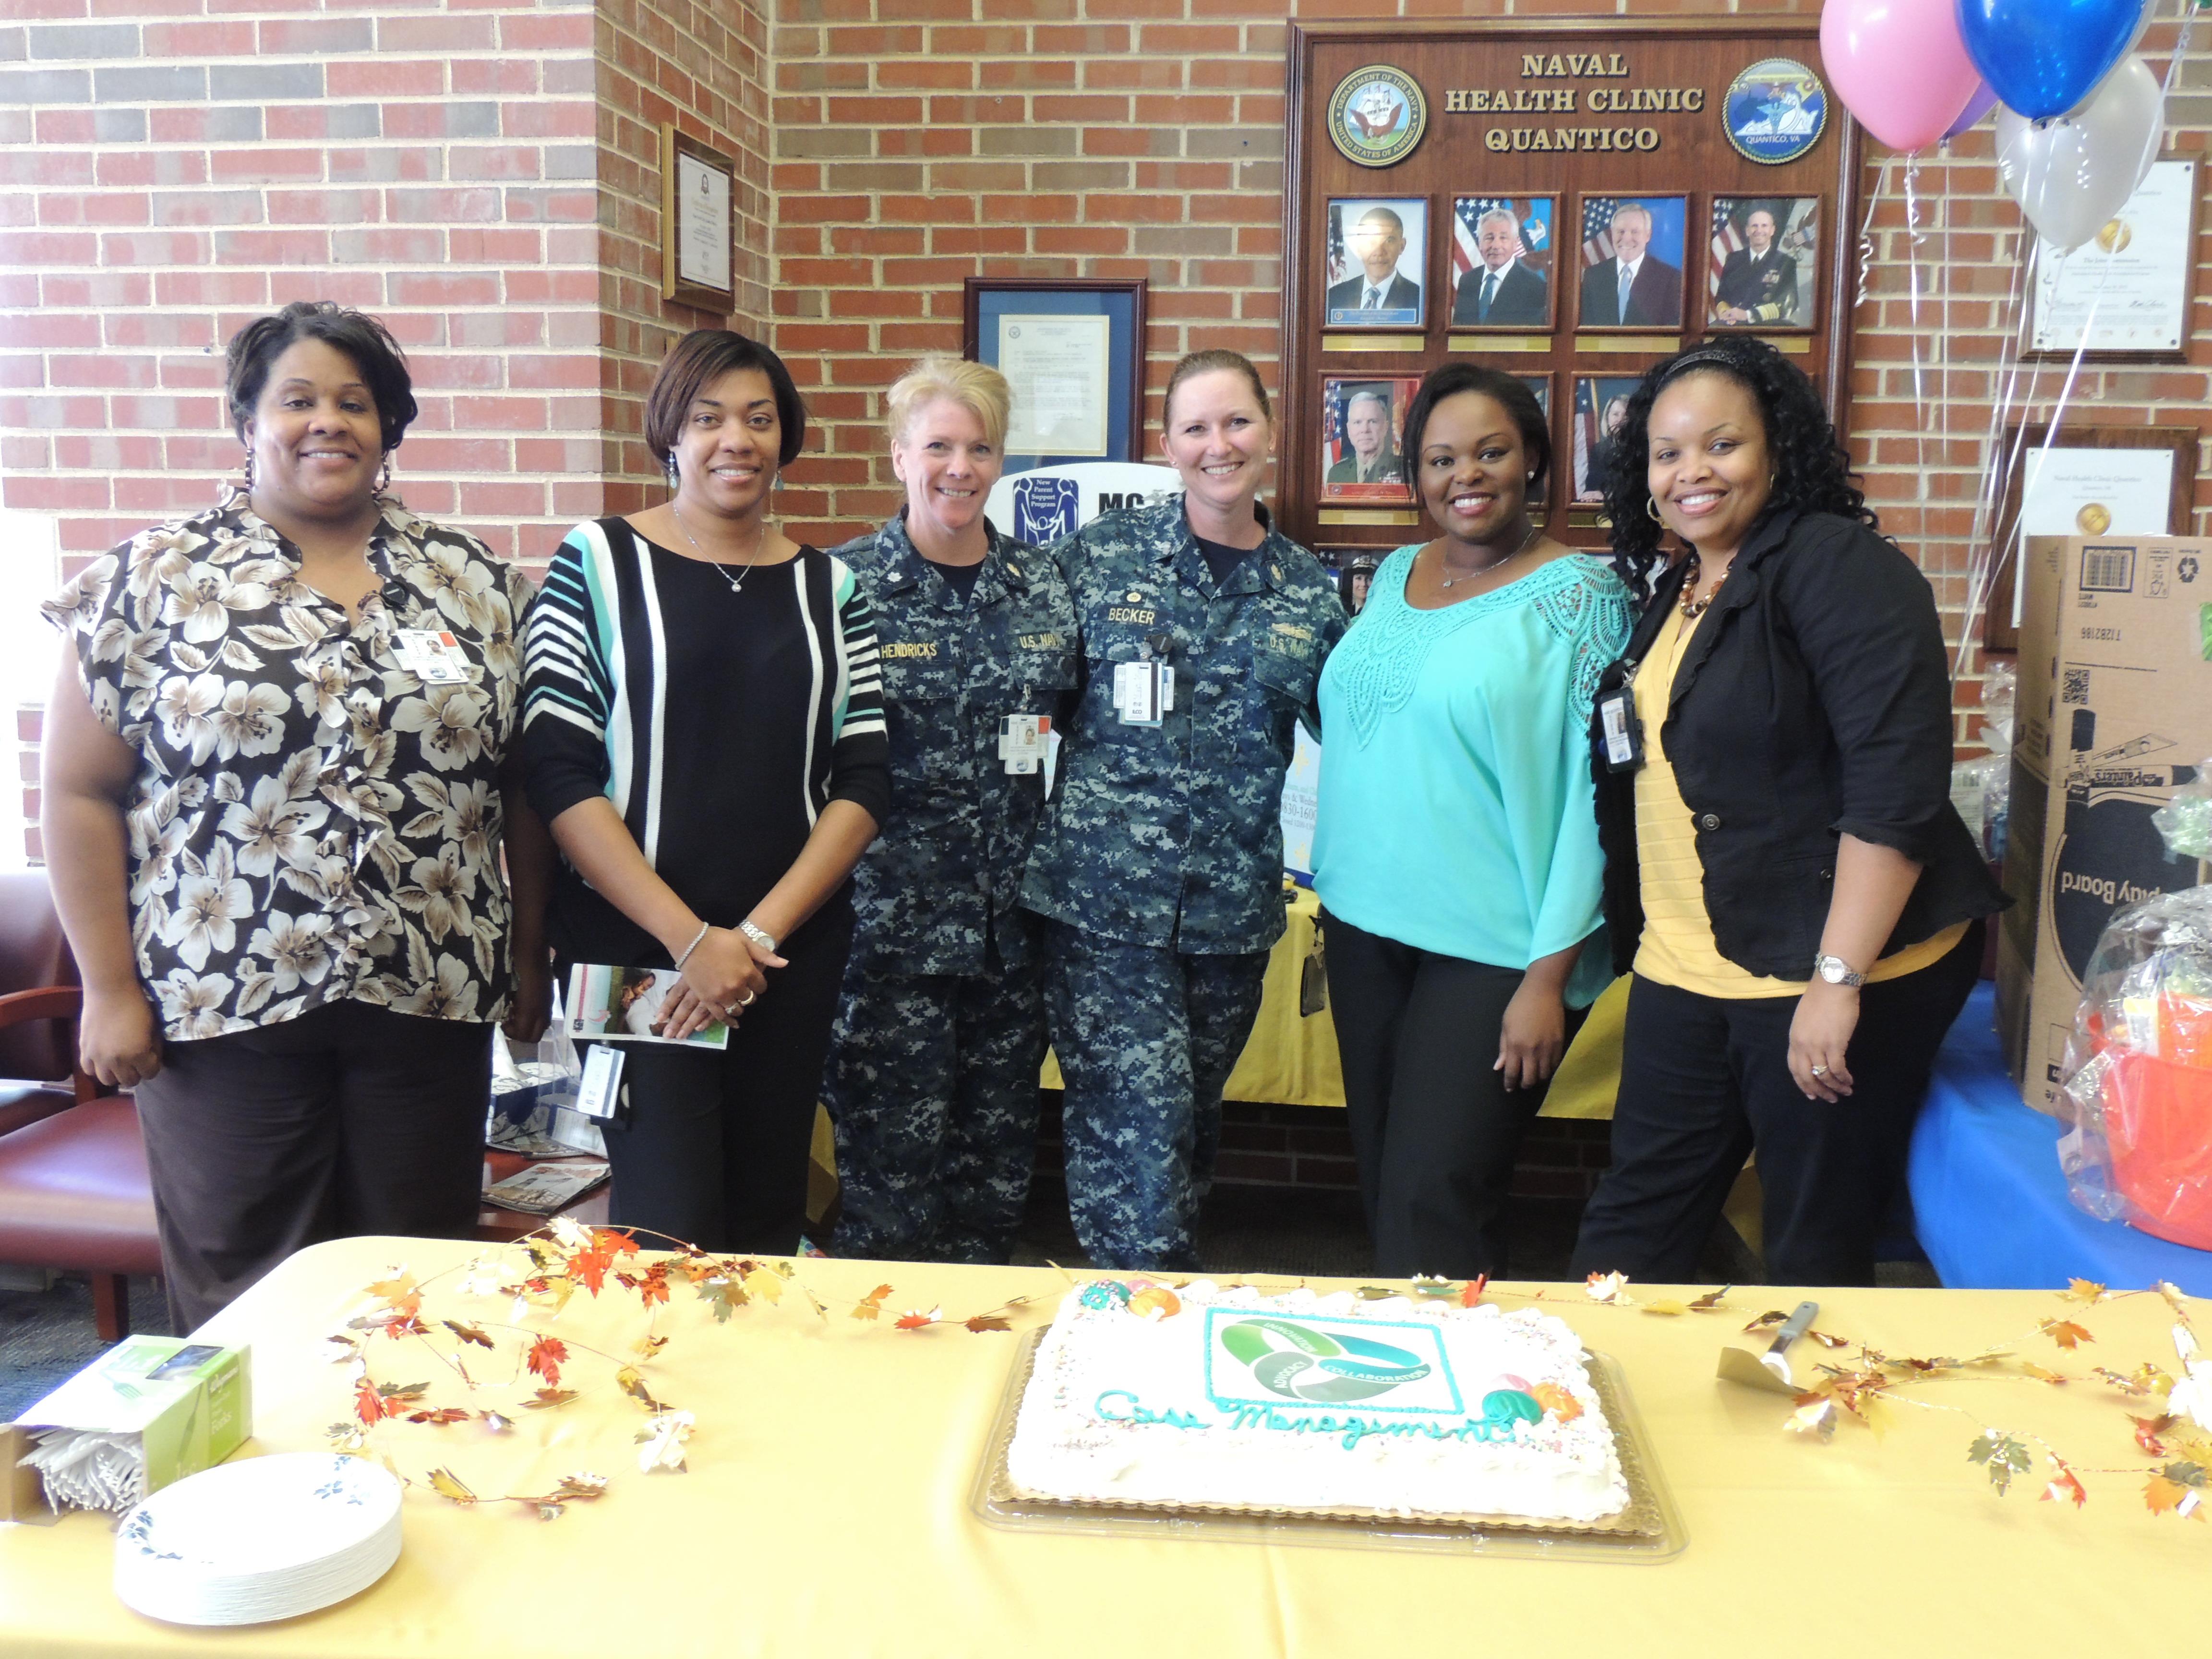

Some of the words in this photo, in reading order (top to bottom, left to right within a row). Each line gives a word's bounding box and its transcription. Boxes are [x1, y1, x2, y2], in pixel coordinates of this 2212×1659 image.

[1521, 54, 1628, 77] NAVAL
[1337, 73, 1380, 109] DEPARTMENT
[1394, 77, 1406, 90] THE
[1405, 89, 1418, 111] NAVY
[1444, 89, 1576, 112] HEALTH
[1587, 88, 1704, 111] CLINIC
[1336, 121, 1353, 148] UNITED
[1352, 145, 1381, 158] STATES
[1394, 122, 1418, 152] AMERICA
[1485, 127, 1660, 151] QUANTICO
[1745, 135, 1788, 144] QUANTICO,
[1791, 134, 1800, 143] VA
[1107, 607, 1155, 625] BECKER
[880, 643, 938, 659] HENDRICKS
[1019, 635, 1038, 649] U.S.
[2061, 870, 2116, 905] Board
[1263, 1322, 1318, 1353] INNOVATION
[1274, 1360, 1309, 1388] ADVOCACY
[1323, 1364, 1429, 1382] COLLABORATION
[1094, 1389, 1213, 1431] Case
[1213, 1396, 1515, 1451] Management
